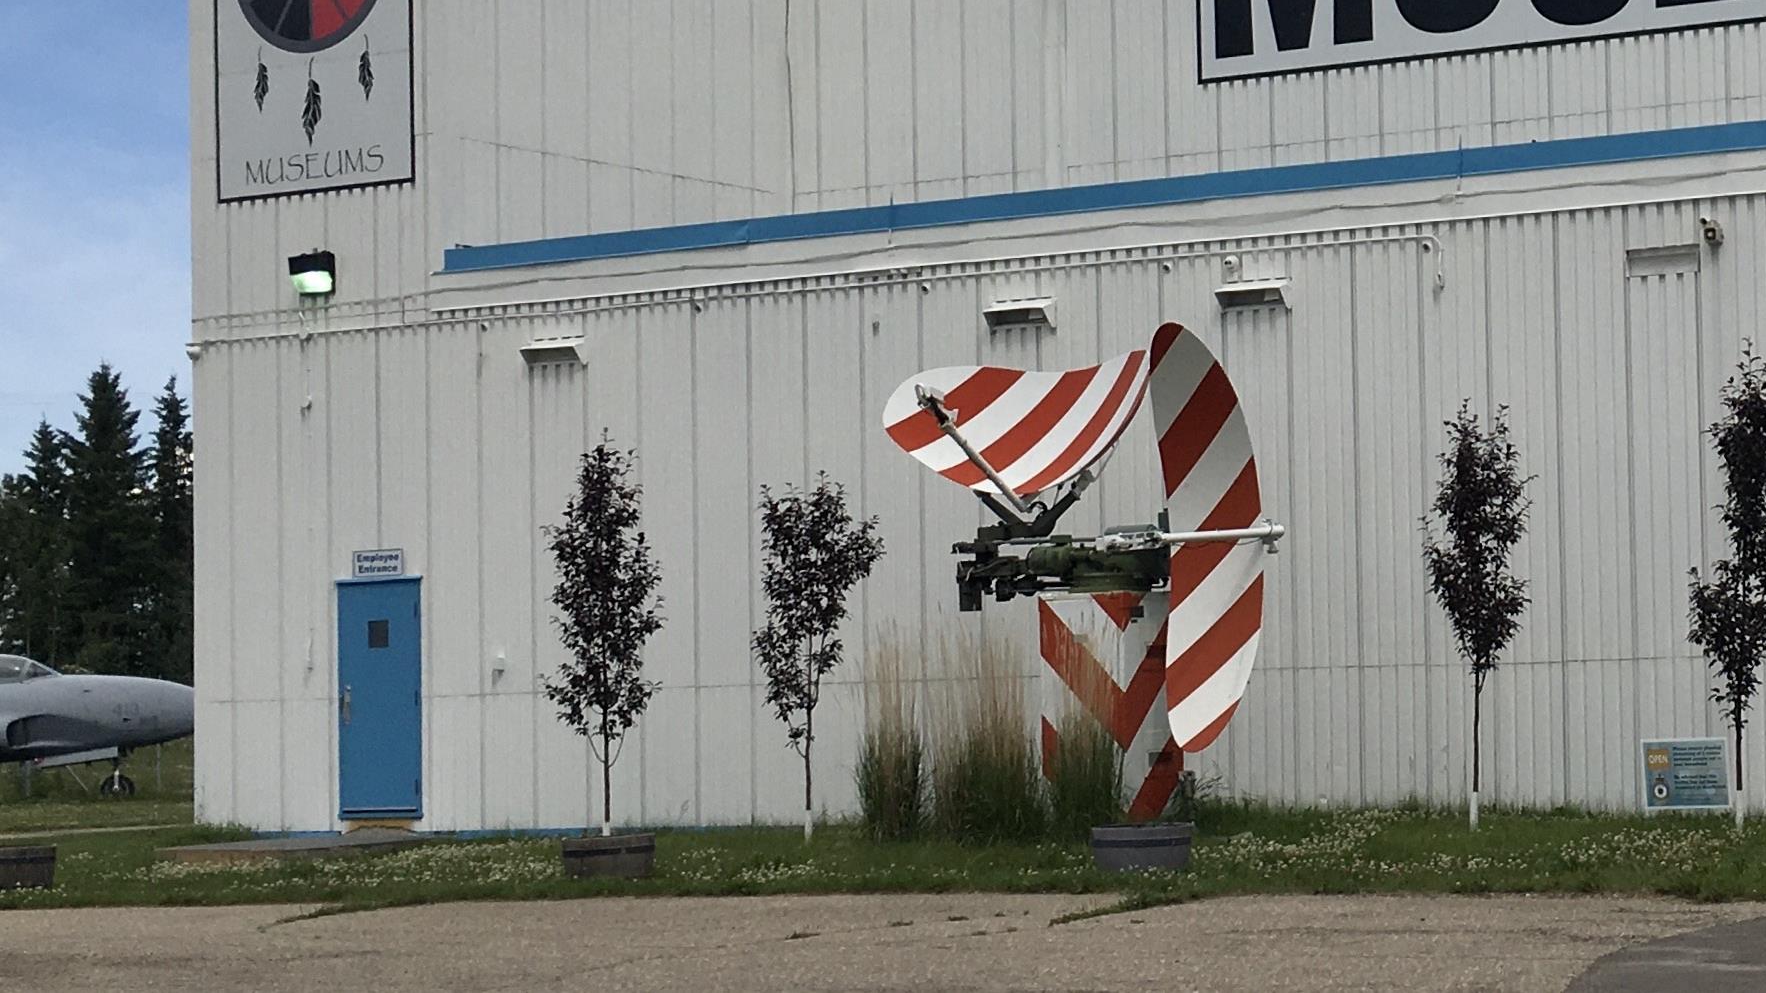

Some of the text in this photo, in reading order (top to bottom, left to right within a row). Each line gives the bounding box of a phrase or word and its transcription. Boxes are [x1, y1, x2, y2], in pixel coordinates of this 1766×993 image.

[245, 144, 384, 186] MUSEUMS
[357, 553, 399, 563] Employee
[358, 565, 398, 573] Entrance
[1648, 754, 1668, 764] OPEN
